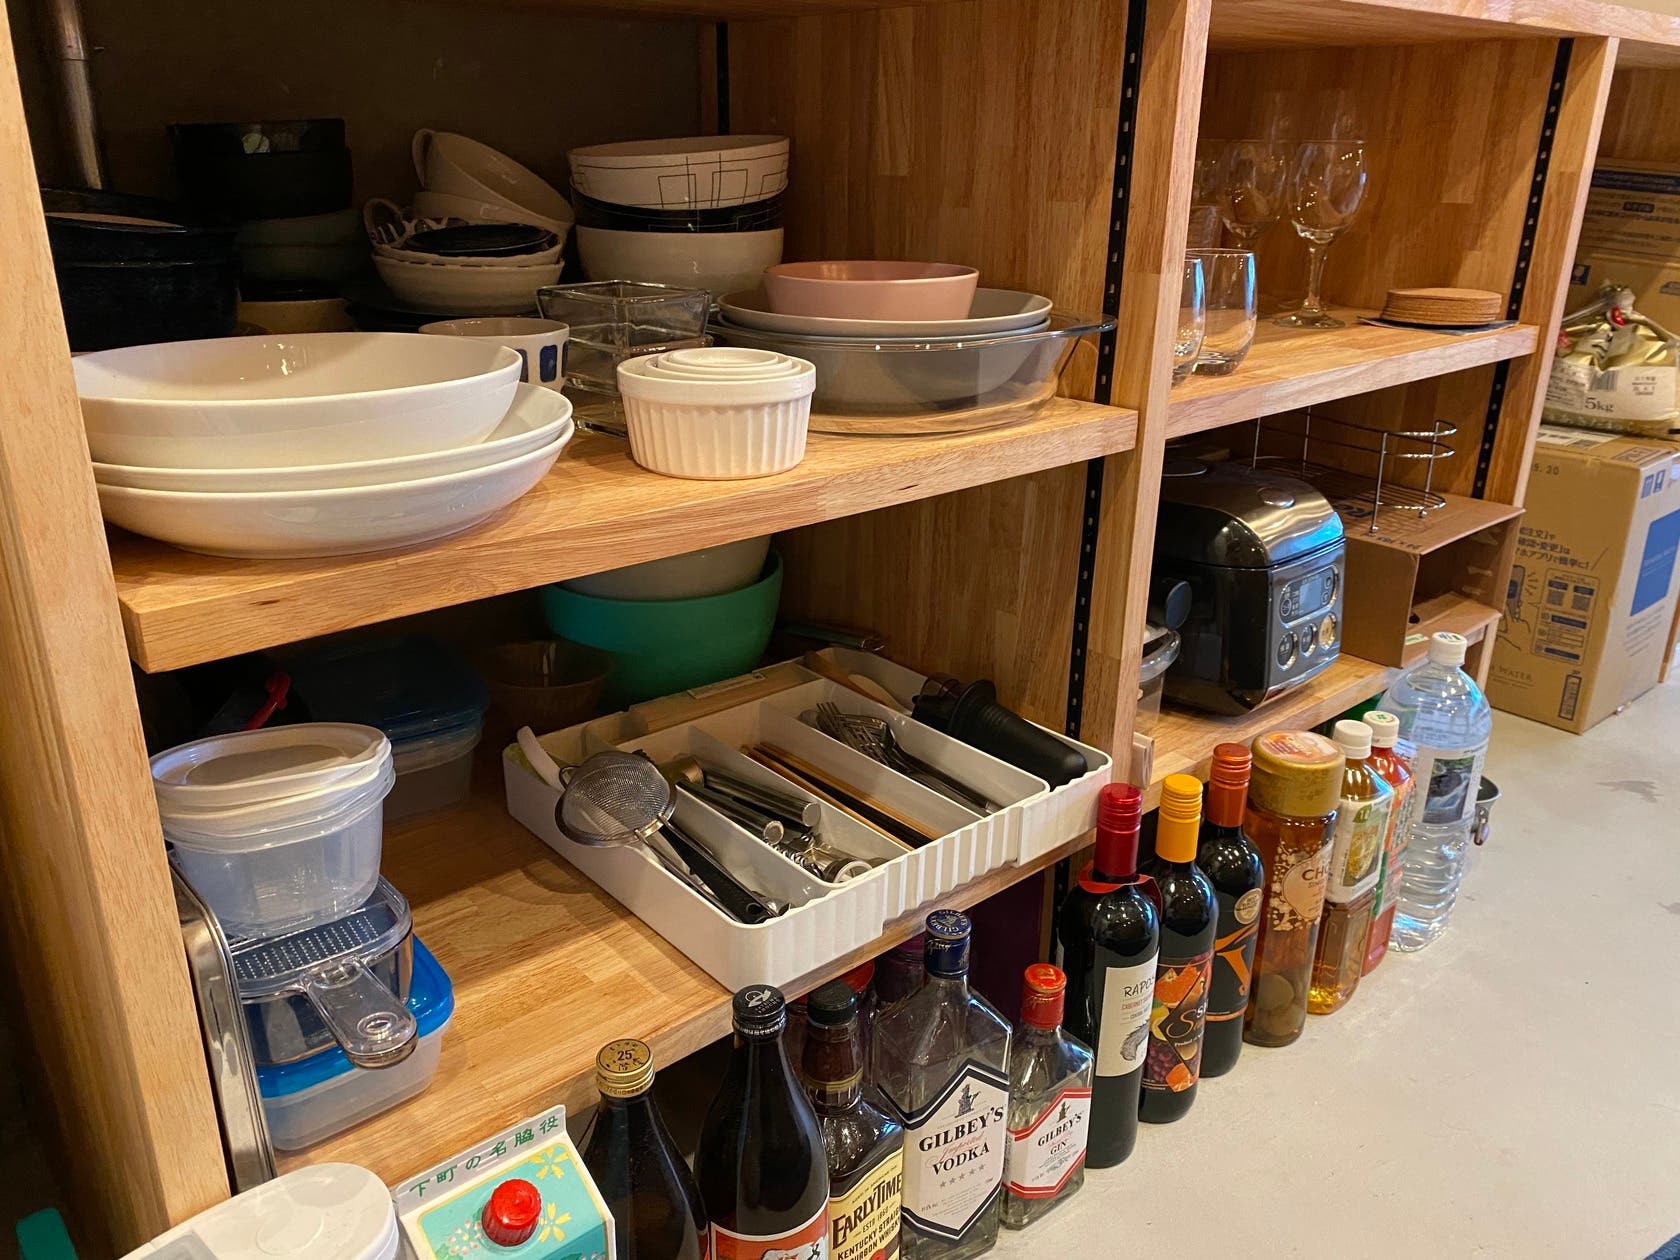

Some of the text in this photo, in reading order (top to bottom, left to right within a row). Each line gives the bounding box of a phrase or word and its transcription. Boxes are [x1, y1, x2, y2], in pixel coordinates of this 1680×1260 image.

[1584, 397, 1614, 412] 5kg
[617, 1050, 632, 1061] 25
[919, 1106, 1004, 1152] GILBEY'S
[1038, 1113, 1082, 1147] GILBEY'S
[409, 1116, 558, 1197] 下町の名脇役
[932, 1141, 990, 1176] VODKA
[1050, 1140, 1068, 1155] GIN
[832, 1191, 876, 1250] EARLY
[837, 1229, 877, 1260] KENTUCKY
